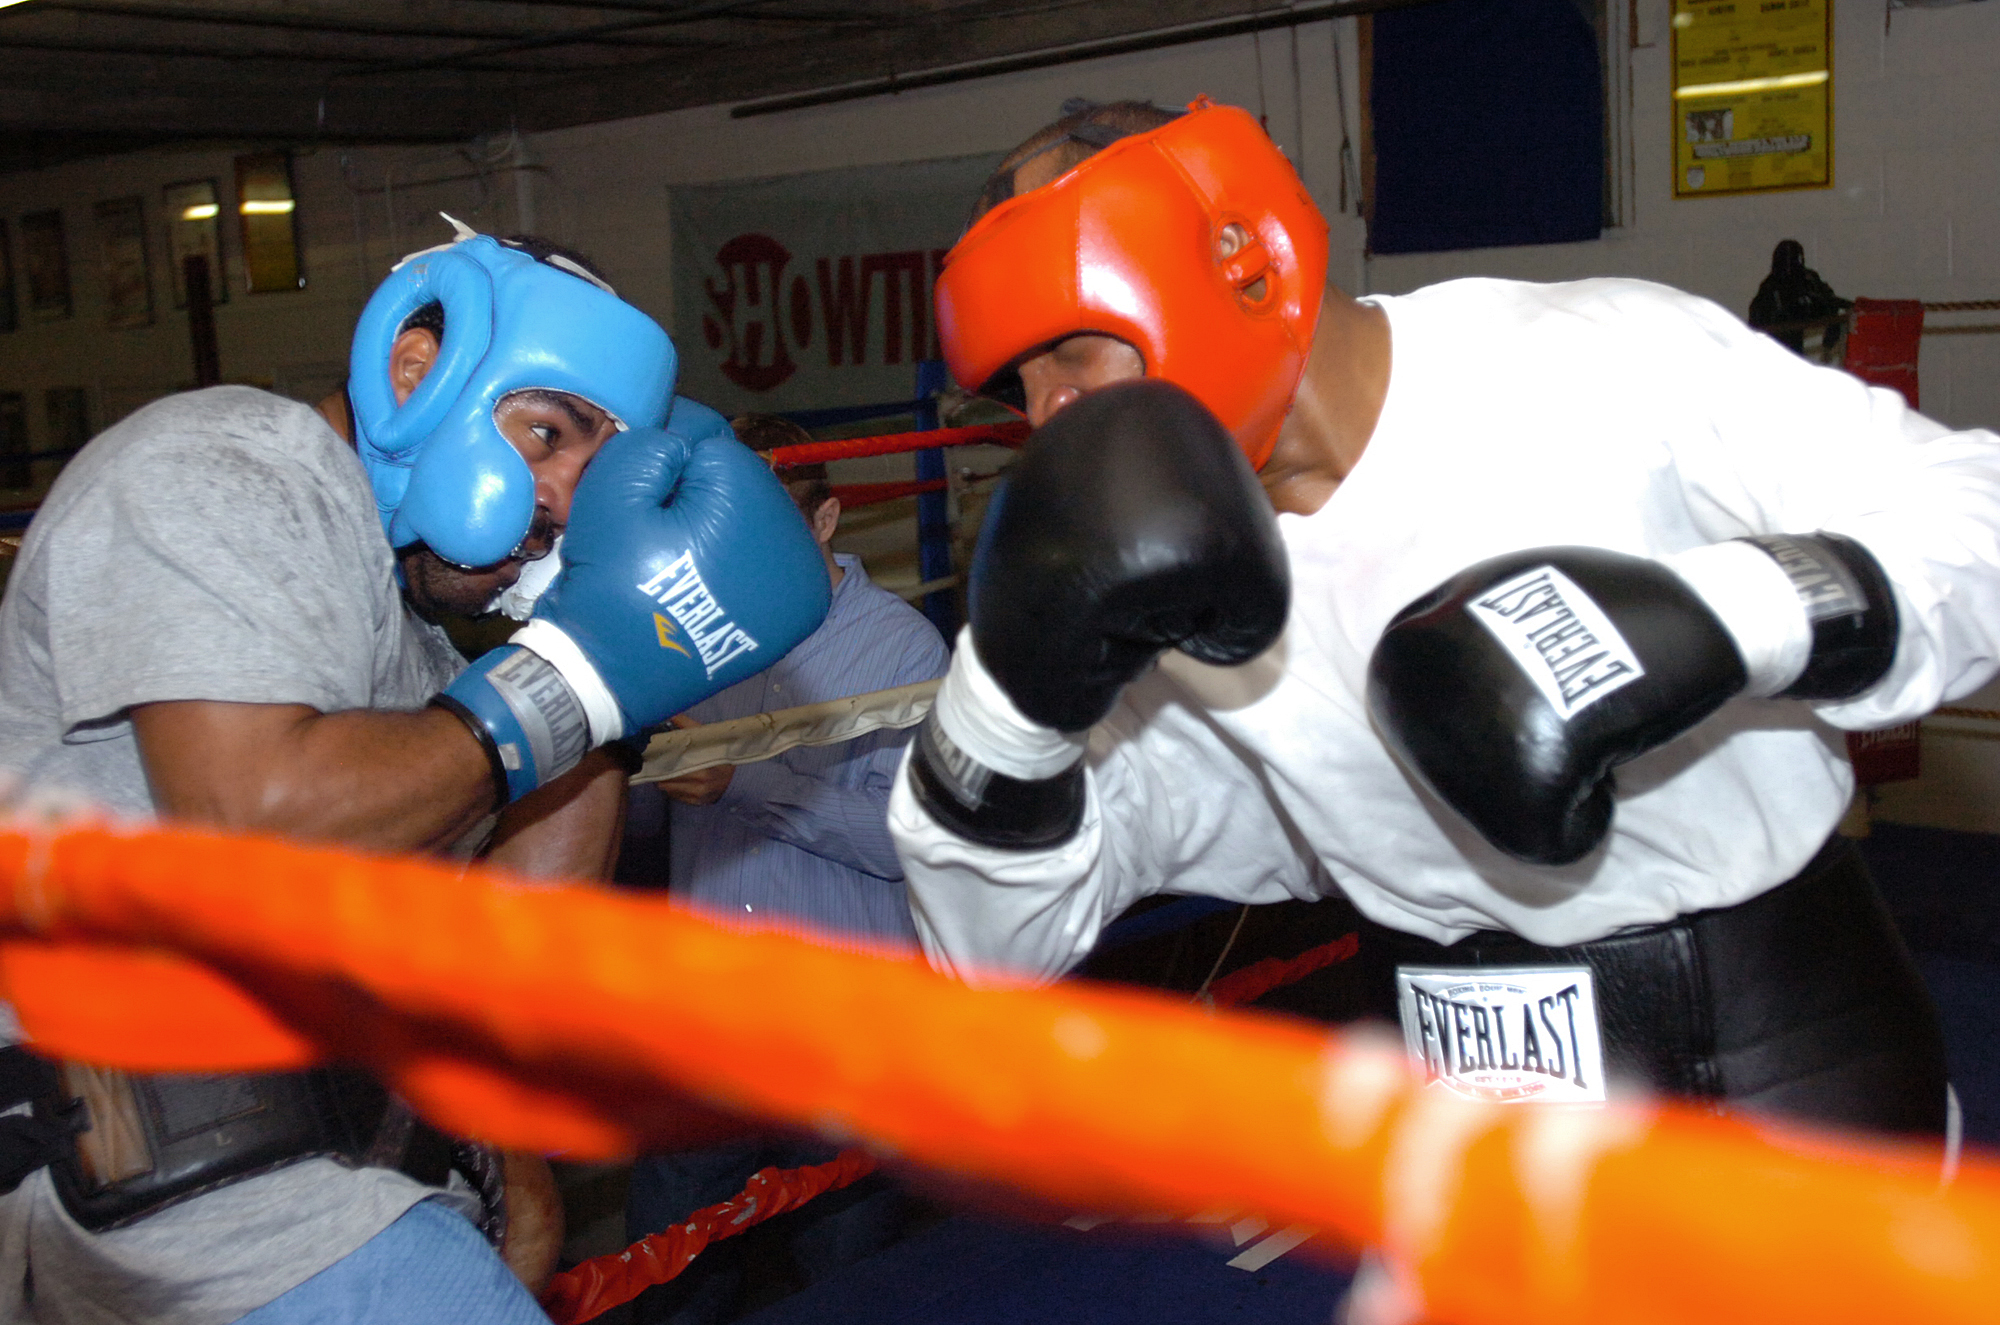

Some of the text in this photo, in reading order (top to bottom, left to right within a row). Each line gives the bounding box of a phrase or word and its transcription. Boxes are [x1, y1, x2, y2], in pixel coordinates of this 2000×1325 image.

[702, 233, 950, 393] SHOWTI
[637, 548, 760, 675] EVERLAST
[1478, 572, 1636, 710] EVERLAST
[1410, 982, 1588, 1089] EVERLAST
